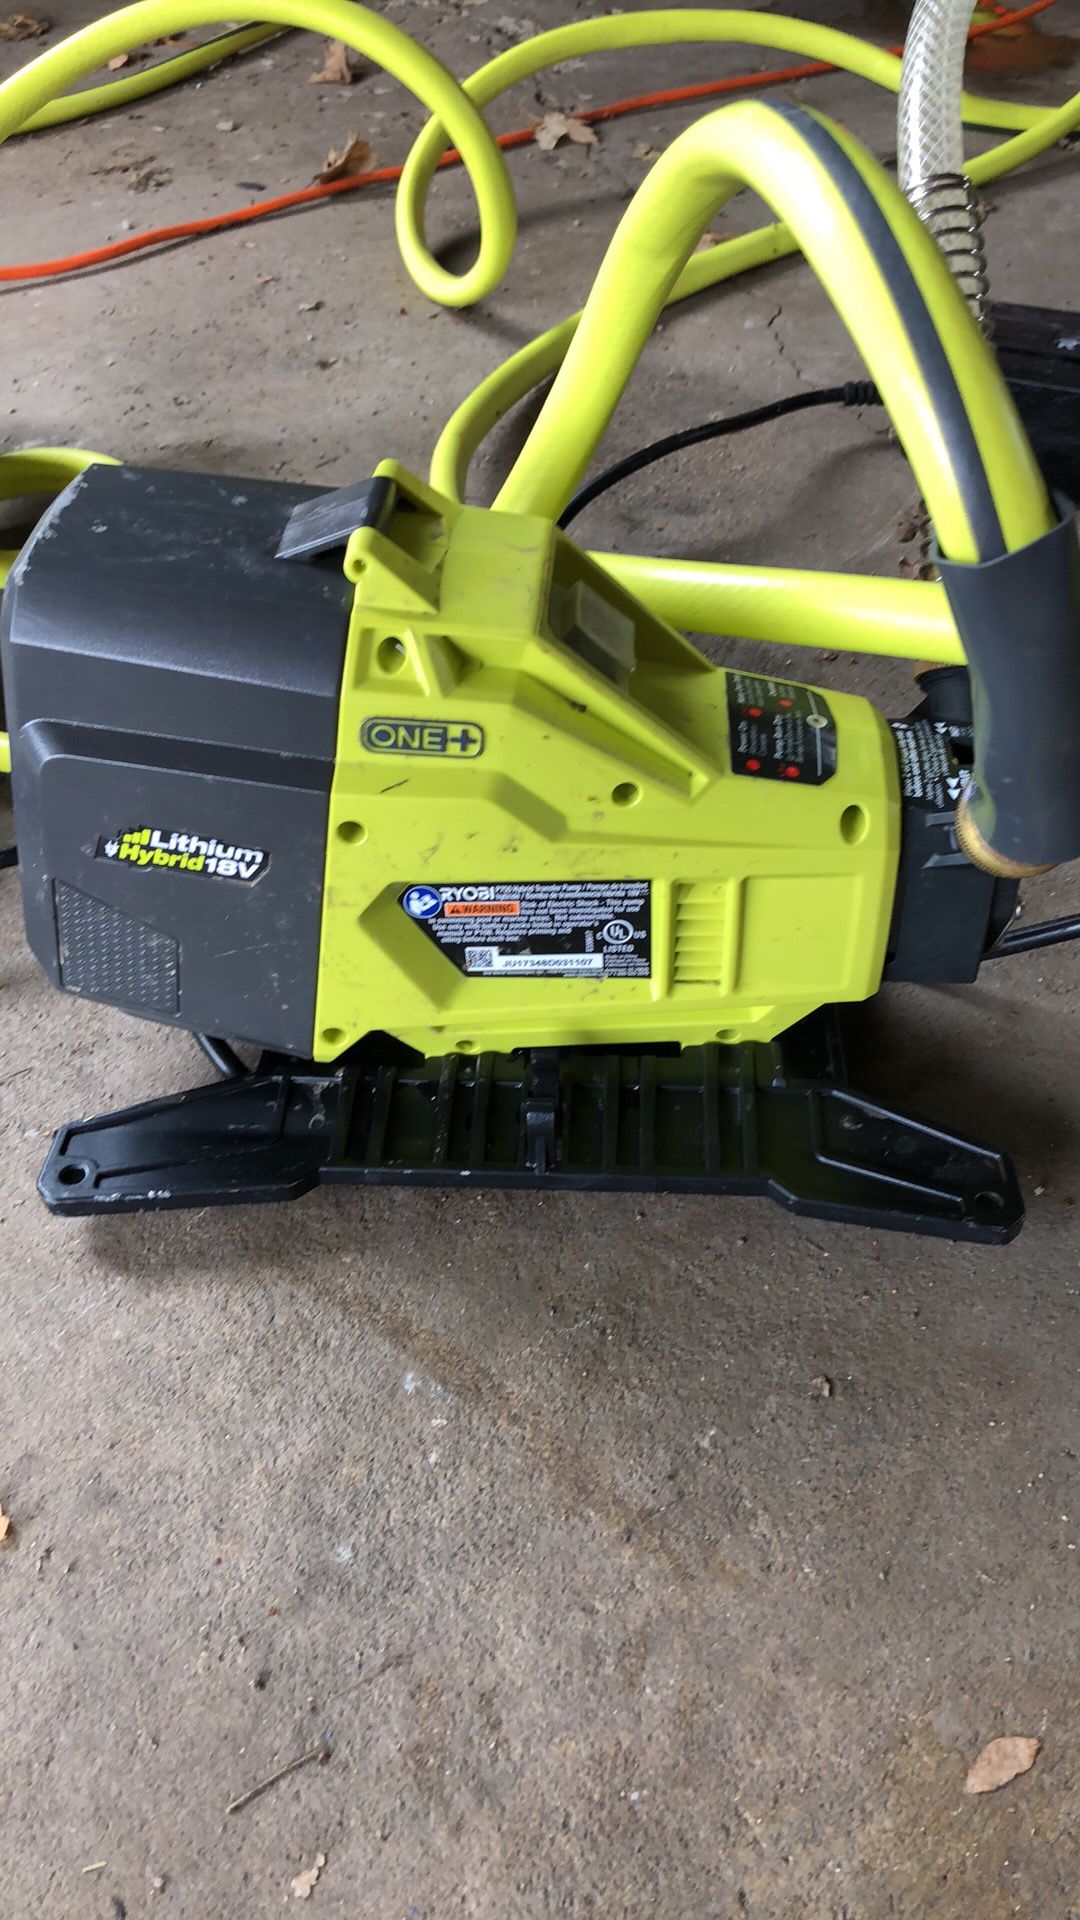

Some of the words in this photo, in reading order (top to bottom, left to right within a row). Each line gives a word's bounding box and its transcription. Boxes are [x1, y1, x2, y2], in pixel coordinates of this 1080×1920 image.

[369, 724, 478, 752] ONE+
[150, 830, 264, 864] Lithium
[119, 843, 206, 872] Hybrid
[205, 857, 260, 879] 18V
[439, 886, 495, 901] RYOBI
[464, 903, 514, 914] WARNING
[603, 945, 635, 953] LISTED
